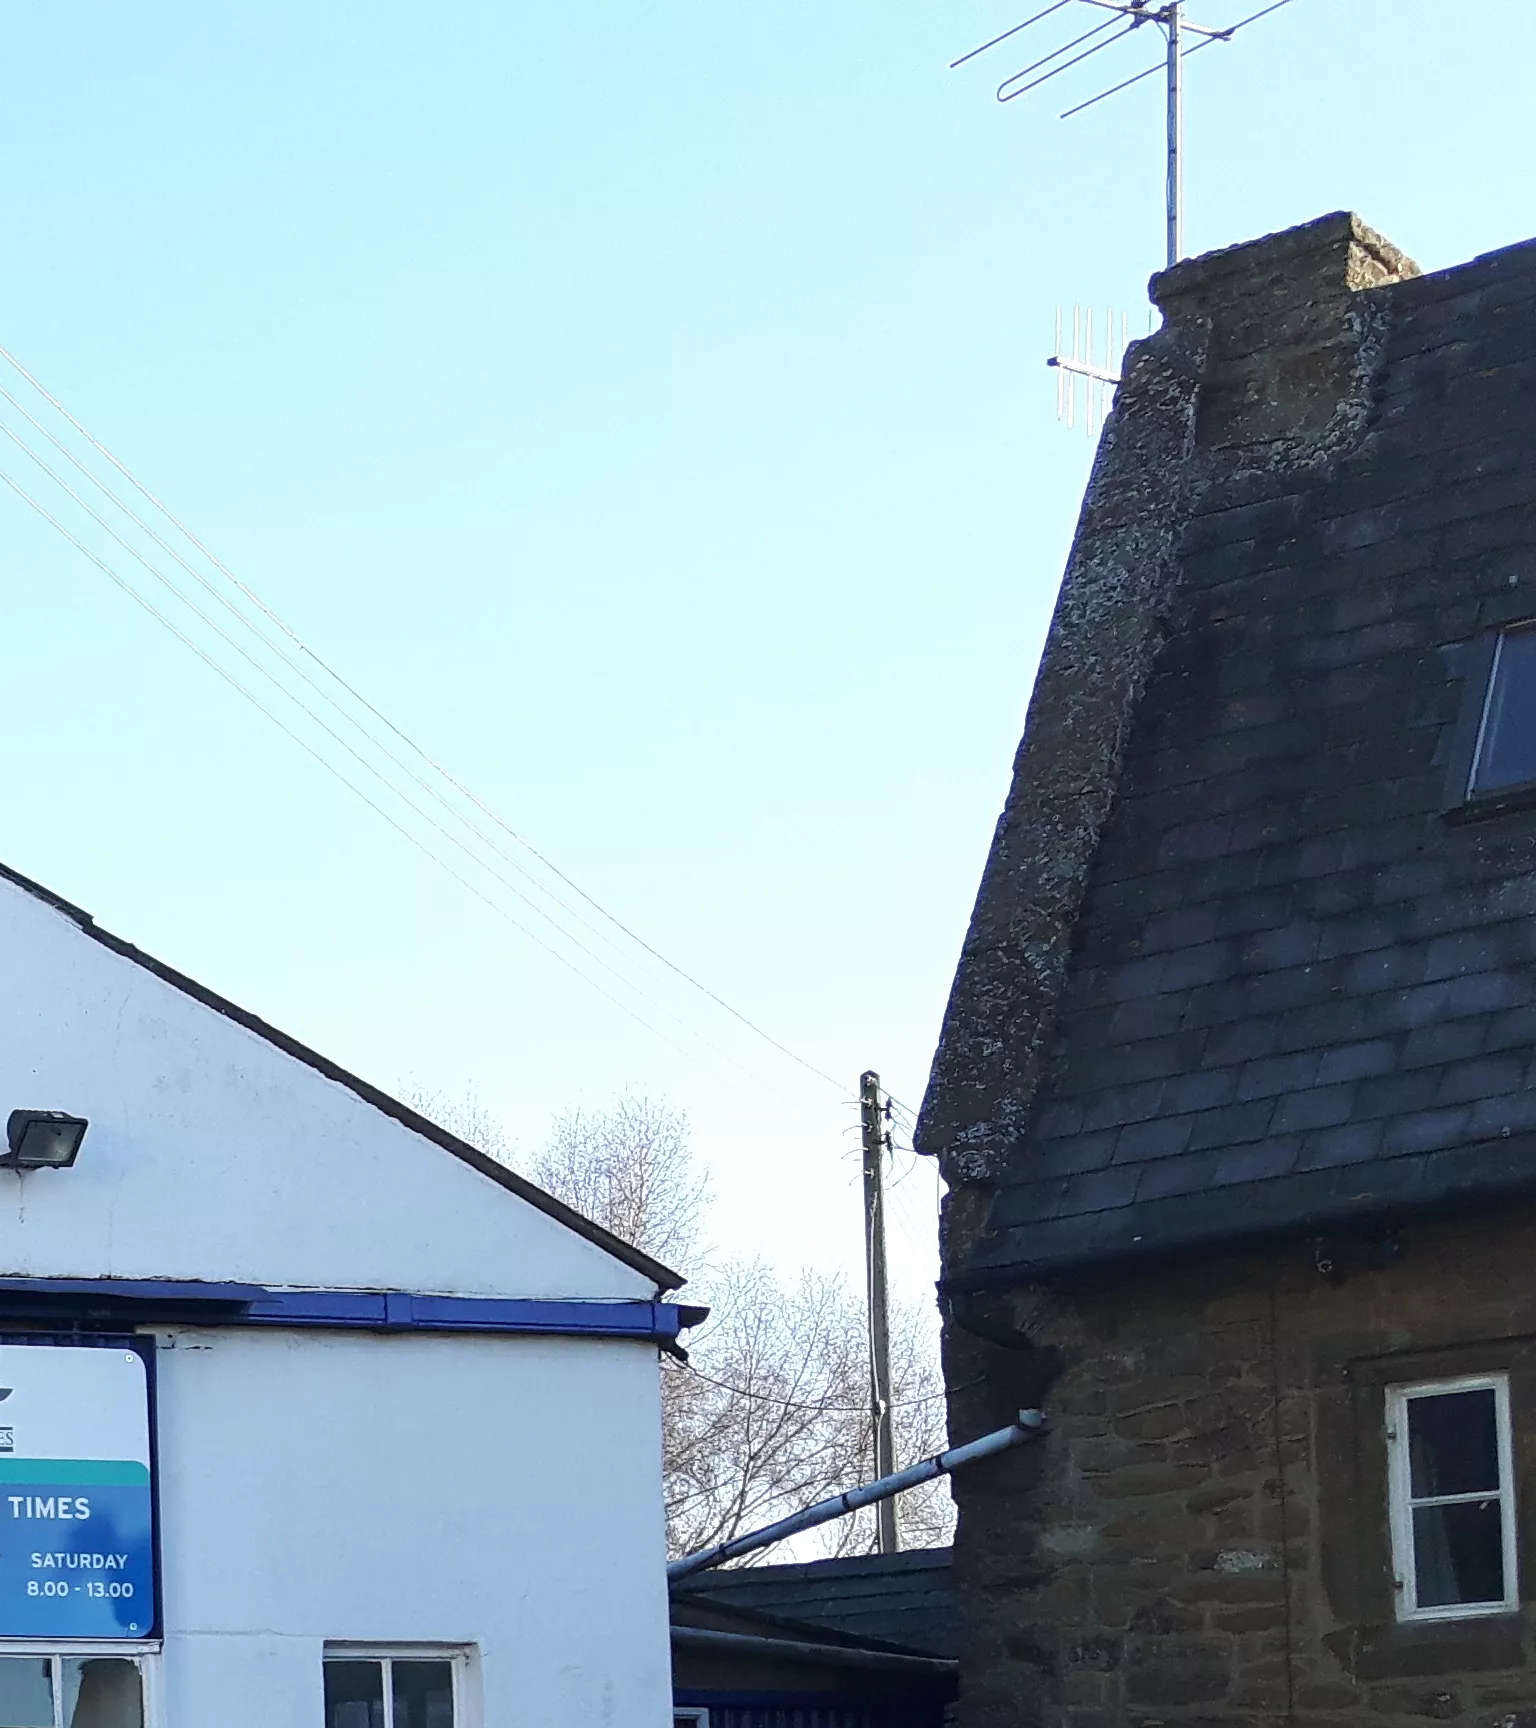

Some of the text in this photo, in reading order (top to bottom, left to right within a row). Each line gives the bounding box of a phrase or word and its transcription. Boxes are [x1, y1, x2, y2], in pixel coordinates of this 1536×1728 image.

[7, 1496, 91, 1520] TIMES
[31, 1552, 128, 1570] SATURDAY
[26, 1580, 69, 1598] 8.00
[86, 1581, 135, 1599] 13.00
